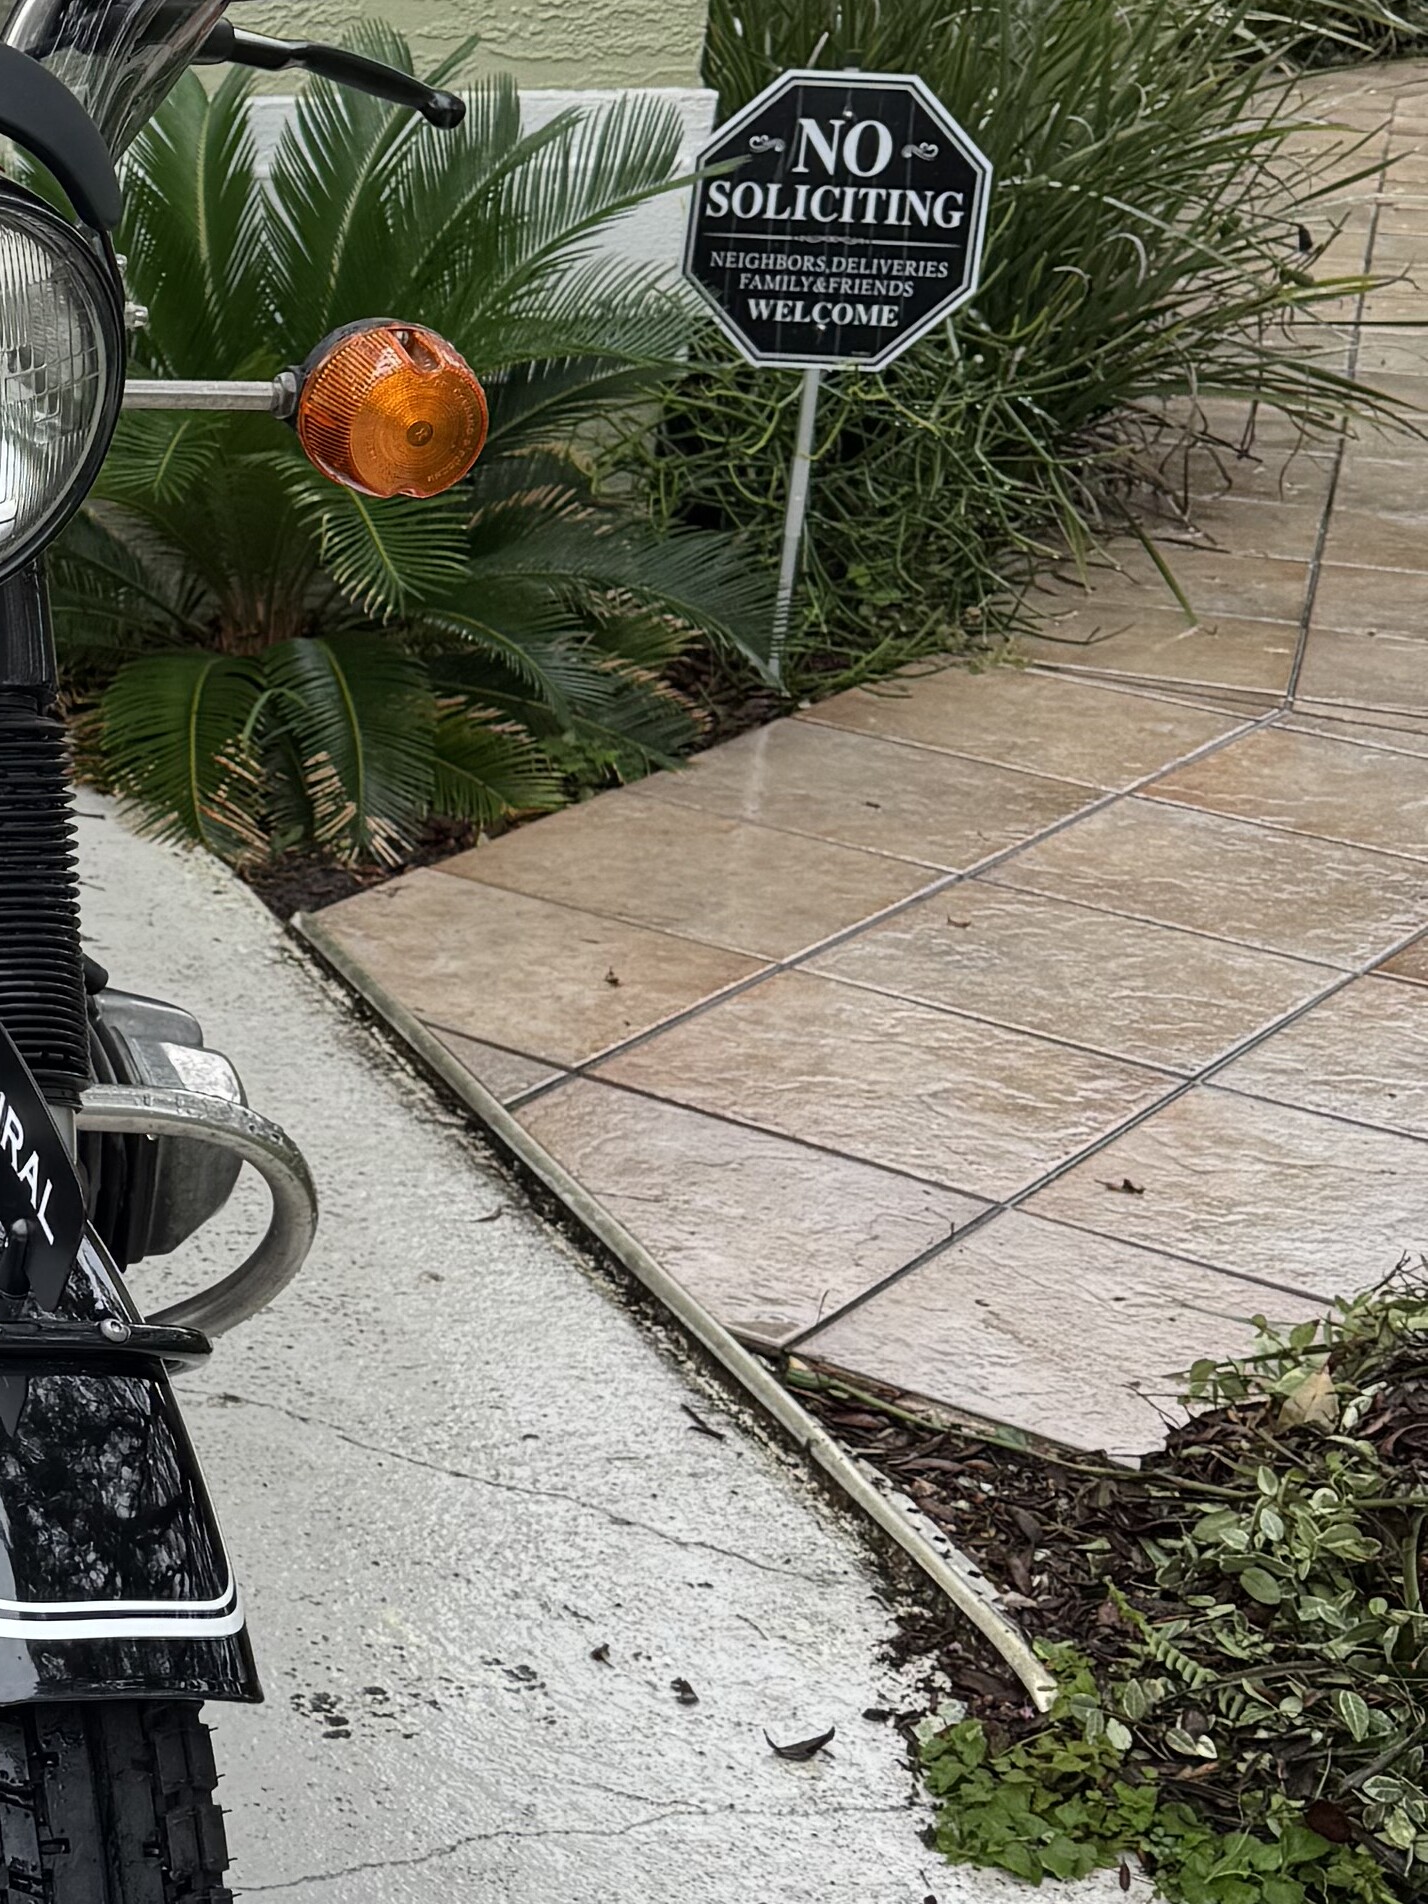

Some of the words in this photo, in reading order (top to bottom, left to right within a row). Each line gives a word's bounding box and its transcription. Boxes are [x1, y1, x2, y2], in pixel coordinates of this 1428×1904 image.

[791, 117, 893, 178] NO
[705, 179, 966, 229] SOLICITING
[747, 297, 900, 328] WELCOME
